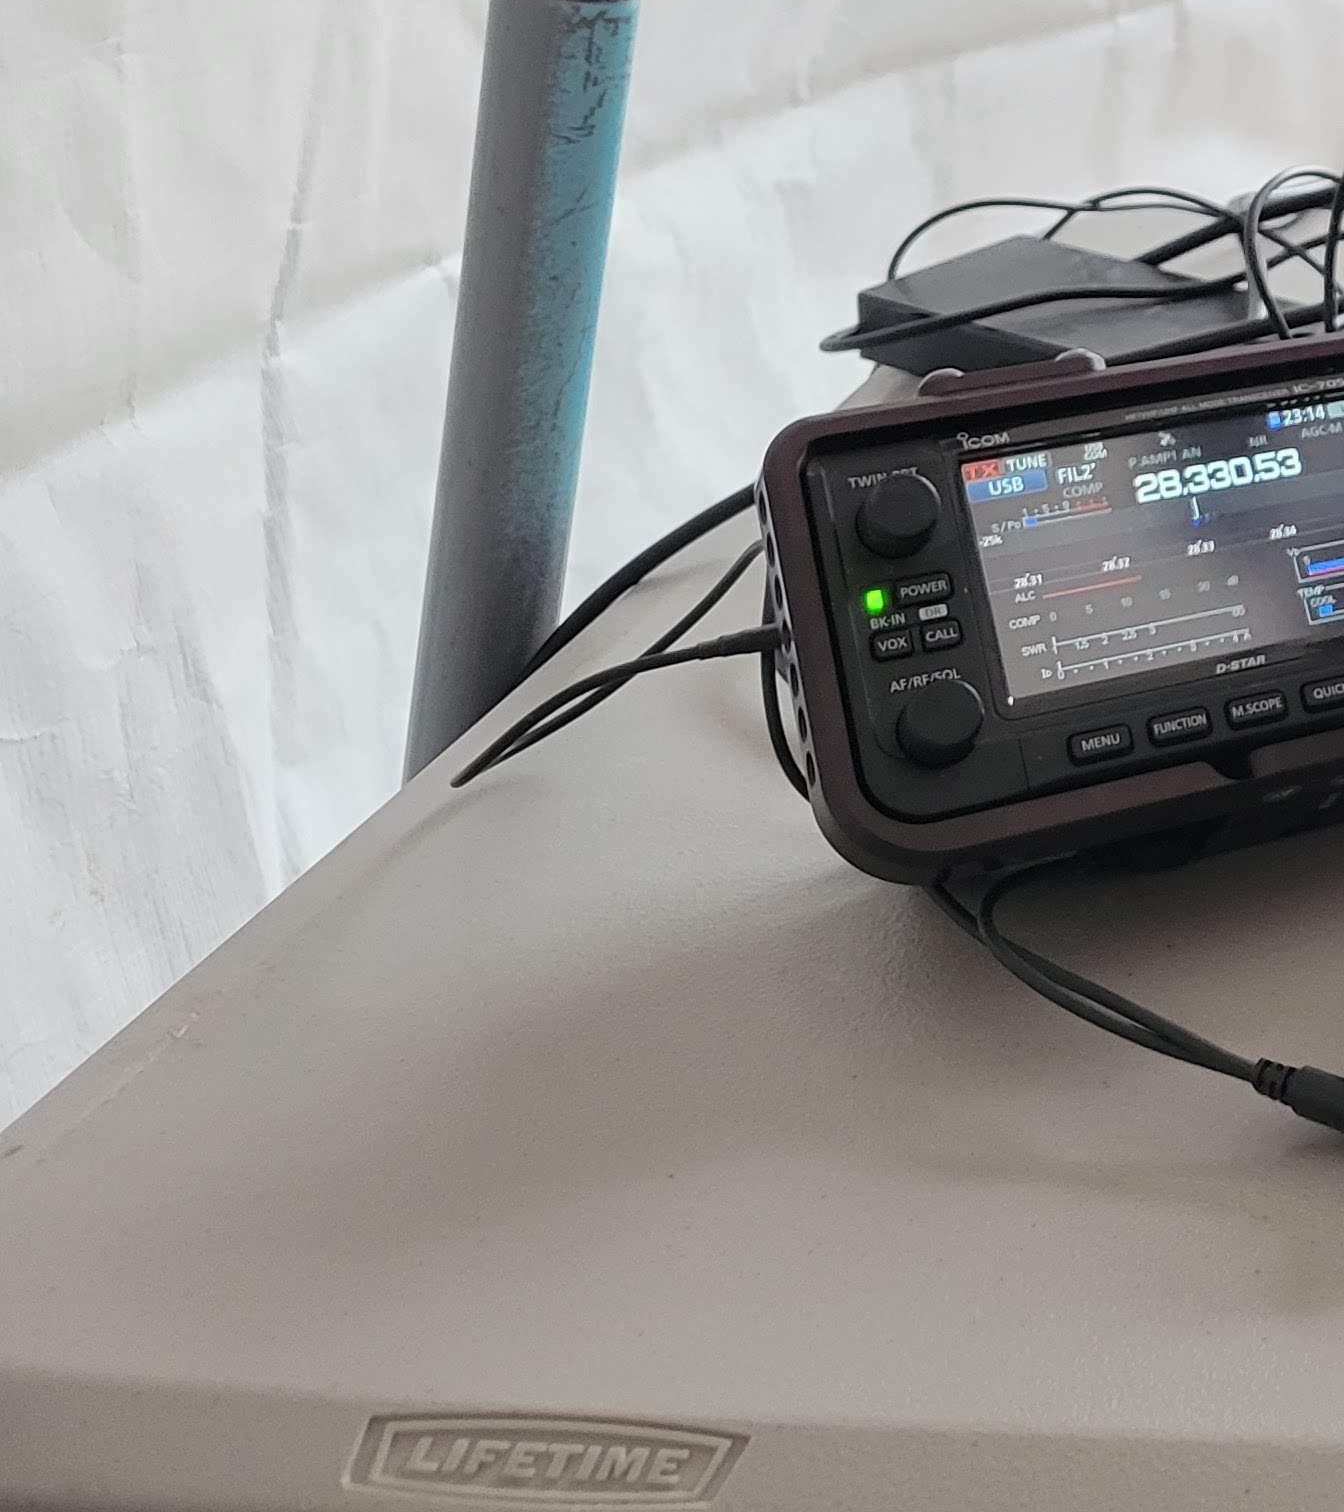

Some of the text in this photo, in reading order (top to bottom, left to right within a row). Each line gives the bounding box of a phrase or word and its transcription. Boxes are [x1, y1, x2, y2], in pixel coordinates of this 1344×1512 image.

[1281, 404, 1325, 427] 23:14
[1006, 454, 1048, 472] TUNE
[988, 476, 1025, 496] USB
[1063, 482, 1103, 498] COMP
[900, 579, 948, 597] POWER
[1015, 590, 1036, 603] ALC
[870, 613, 906, 630] BK-IN
[1009, 615, 1041, 629] COMP
[1085, 604, 1093, 614] 5
[925, 627, 958, 642] CALL
[878, 637, 908, 652] VOX
[1022, 644, 1047, 657] SWR
[1215, 654, 1266, 675] D-STAR
[1232, 696, 1283, 719] M.SCOPE
[1153, 713, 1207, 736] FUNCTION
[1081, 733, 1120, 752] MENU
[404, 1435, 690, 1485] LIFETIME
